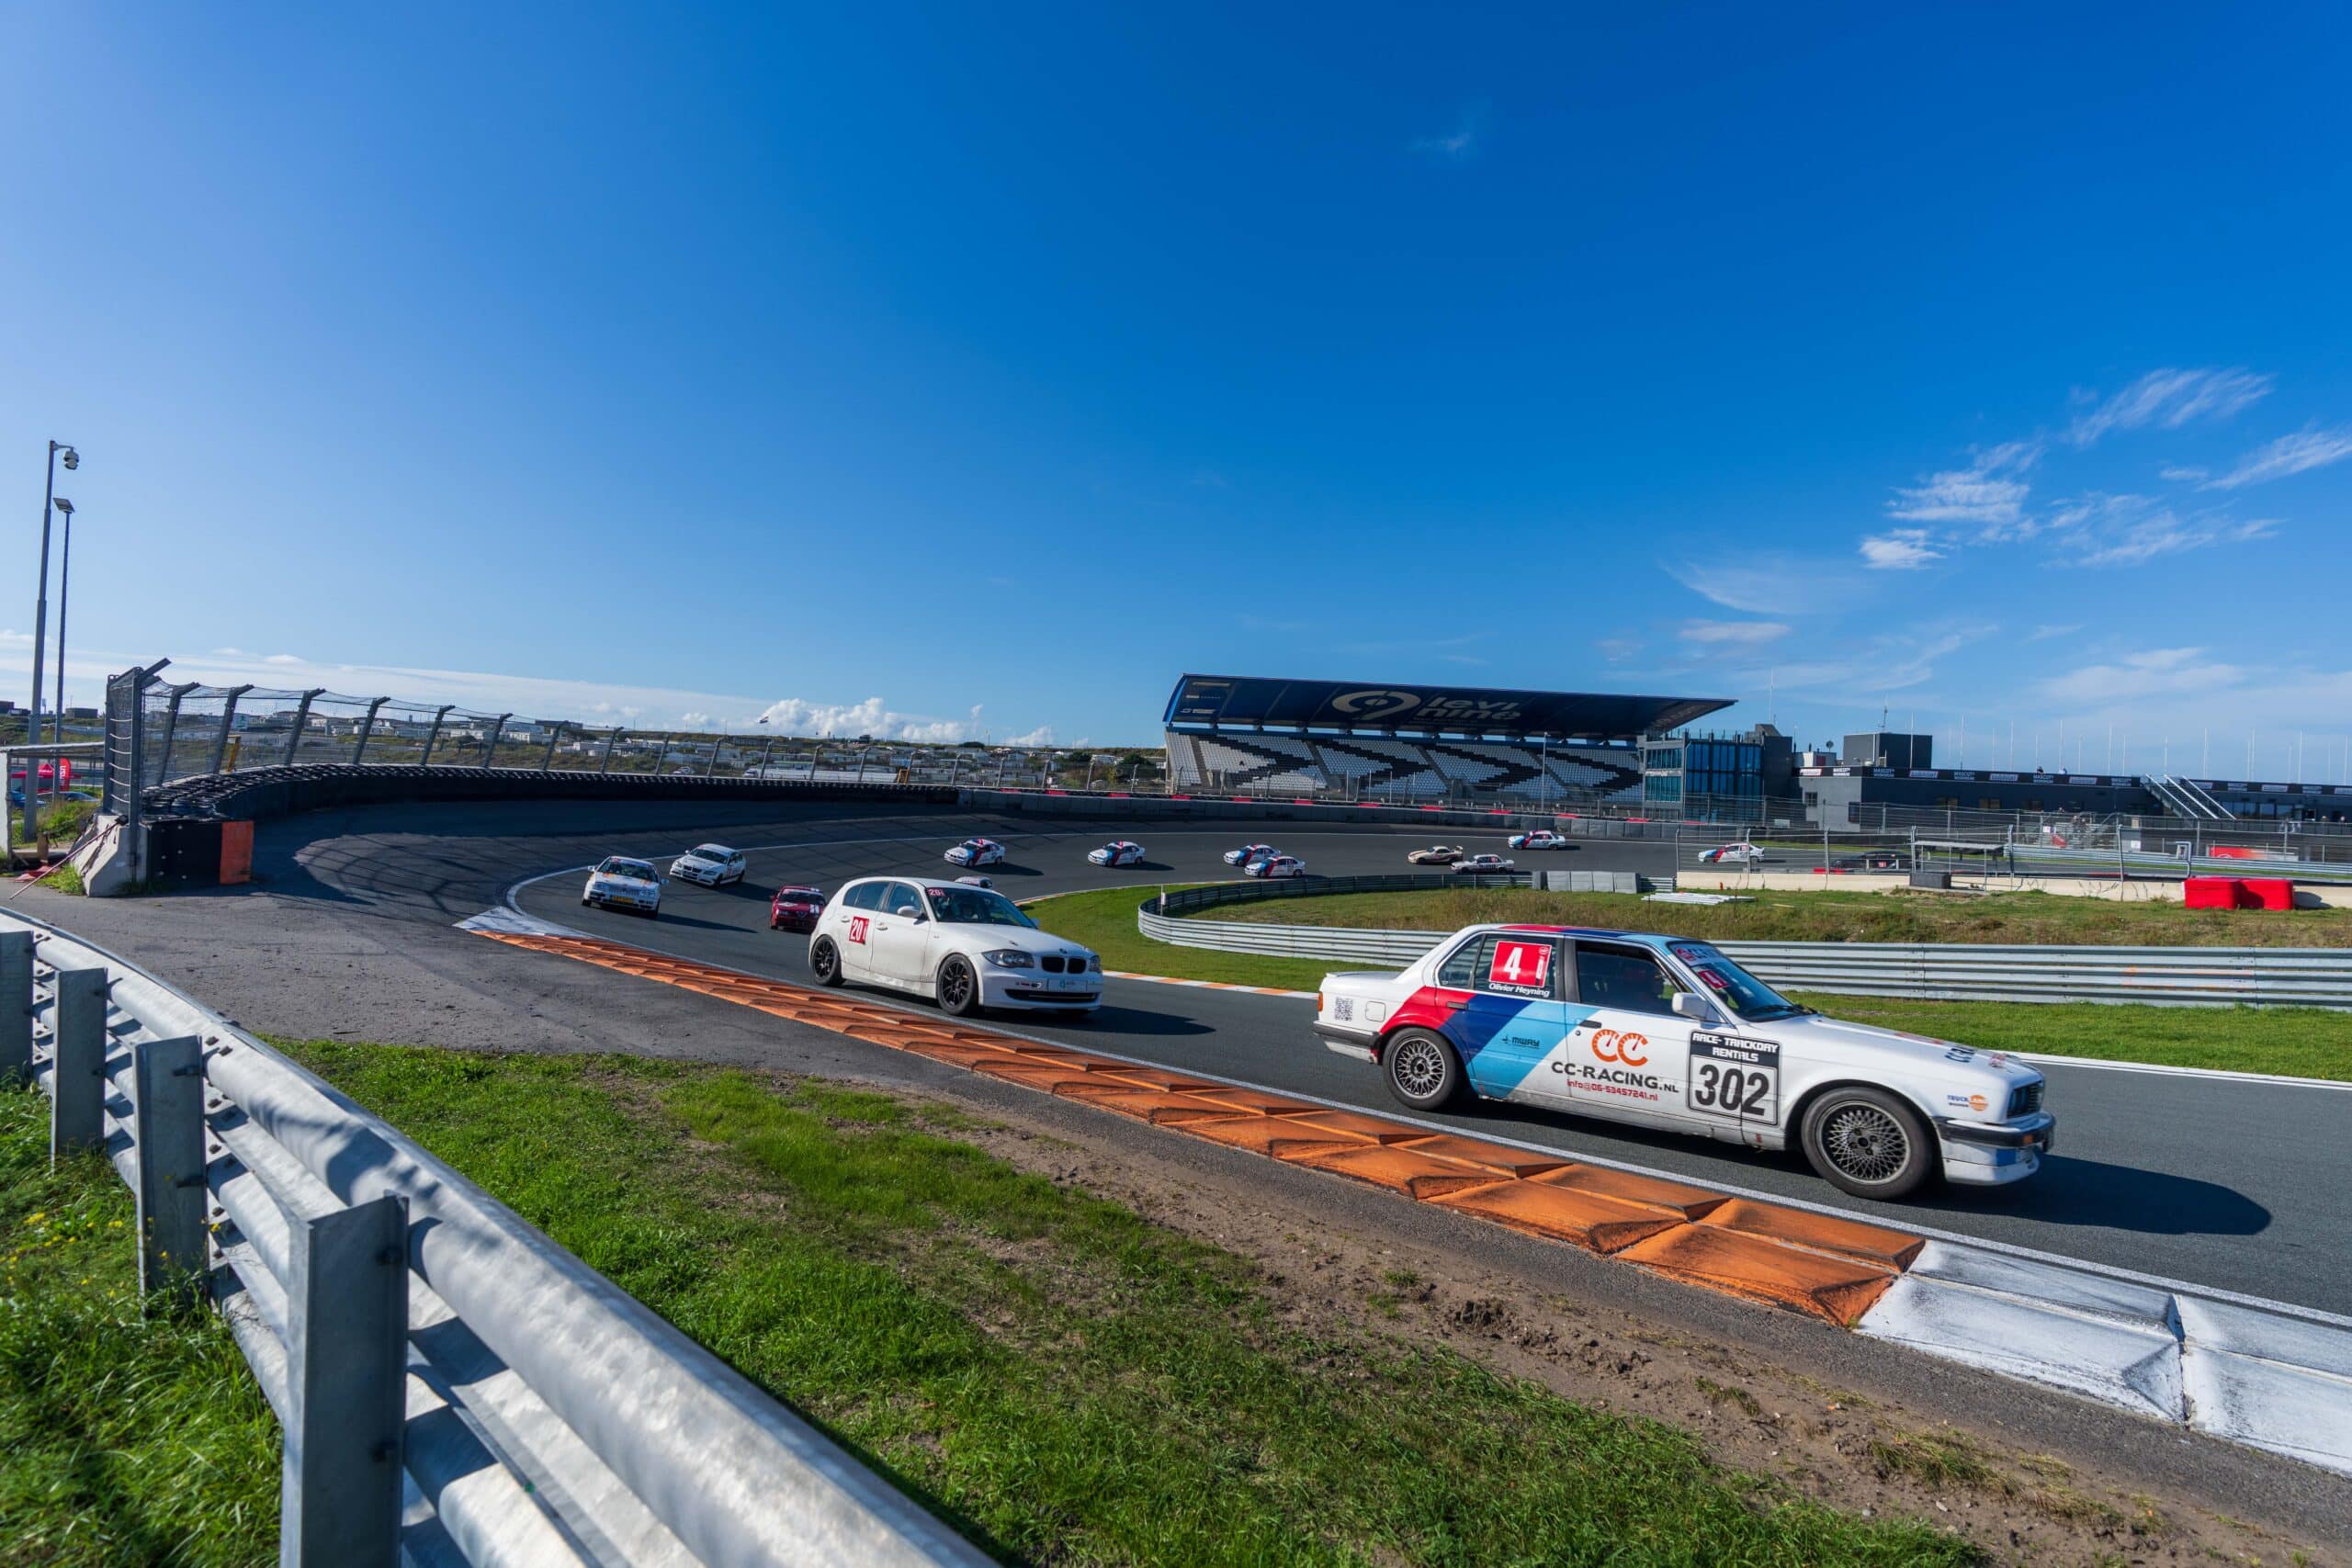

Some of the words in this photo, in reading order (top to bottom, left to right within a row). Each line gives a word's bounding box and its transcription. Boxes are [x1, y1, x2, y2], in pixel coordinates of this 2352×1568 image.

[1503, 946, 1523, 980] 4
[1488, 982, 1514, 993] Olivier
[1514, 985, 1550, 998] Heyning
[1712, 1046, 1759, 1062] RENTALS
[1724, 1036, 1779, 1054] TRACKDAY
[1551, 1061, 1680, 1093] CC-RACING.NL
[1694, 1064, 1770, 1116] 302
